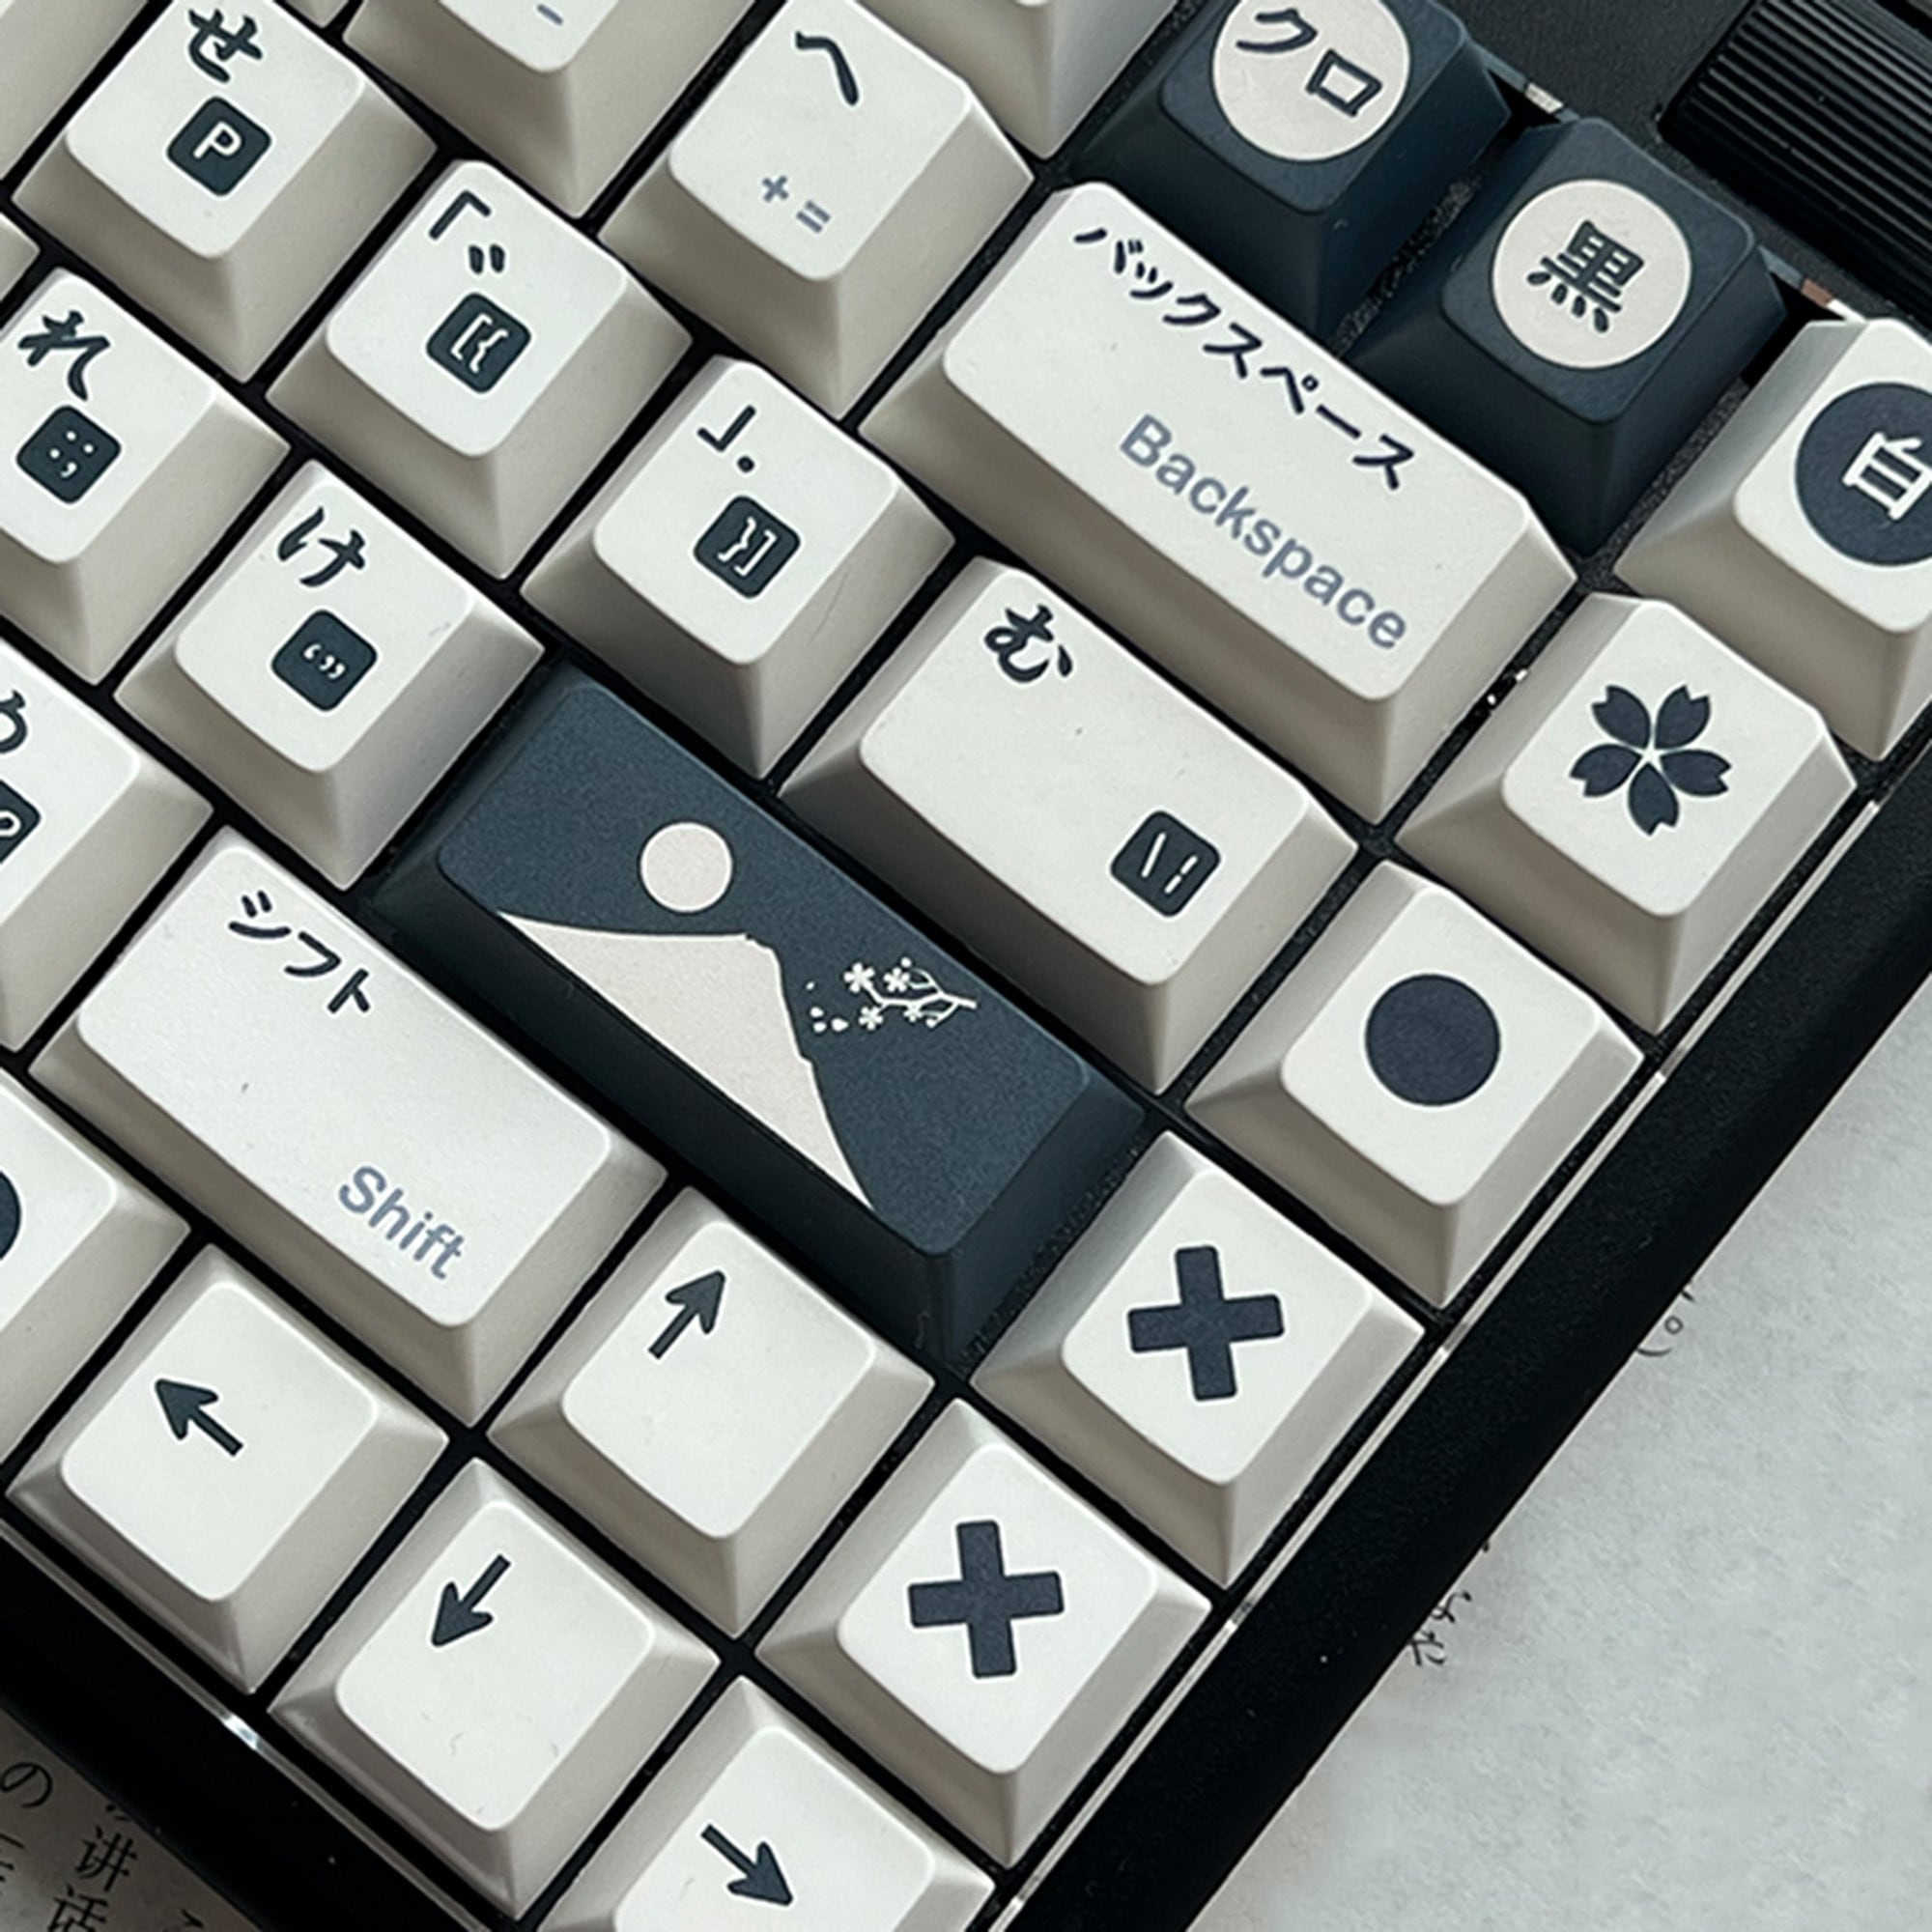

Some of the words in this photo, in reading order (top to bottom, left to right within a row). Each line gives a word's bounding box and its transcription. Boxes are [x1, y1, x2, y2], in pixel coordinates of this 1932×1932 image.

[188, 9, 262, 83] せ
[1236, 8, 1382, 117] クロ
[1526, 220, 1645, 333] 黒
[17, 310, 110, 401] れ
[1073, 227, 1415, 491] バックスペース
[277, 506, 366, 587] け
[1120, 413, 1406, 650] Backspace
[984, 605, 1073, 683] む
[229, 890, 370, 1014] シフト
[339, 1166, 465, 1279] Shift
[48, 1803, 138, 1932] 讲话
